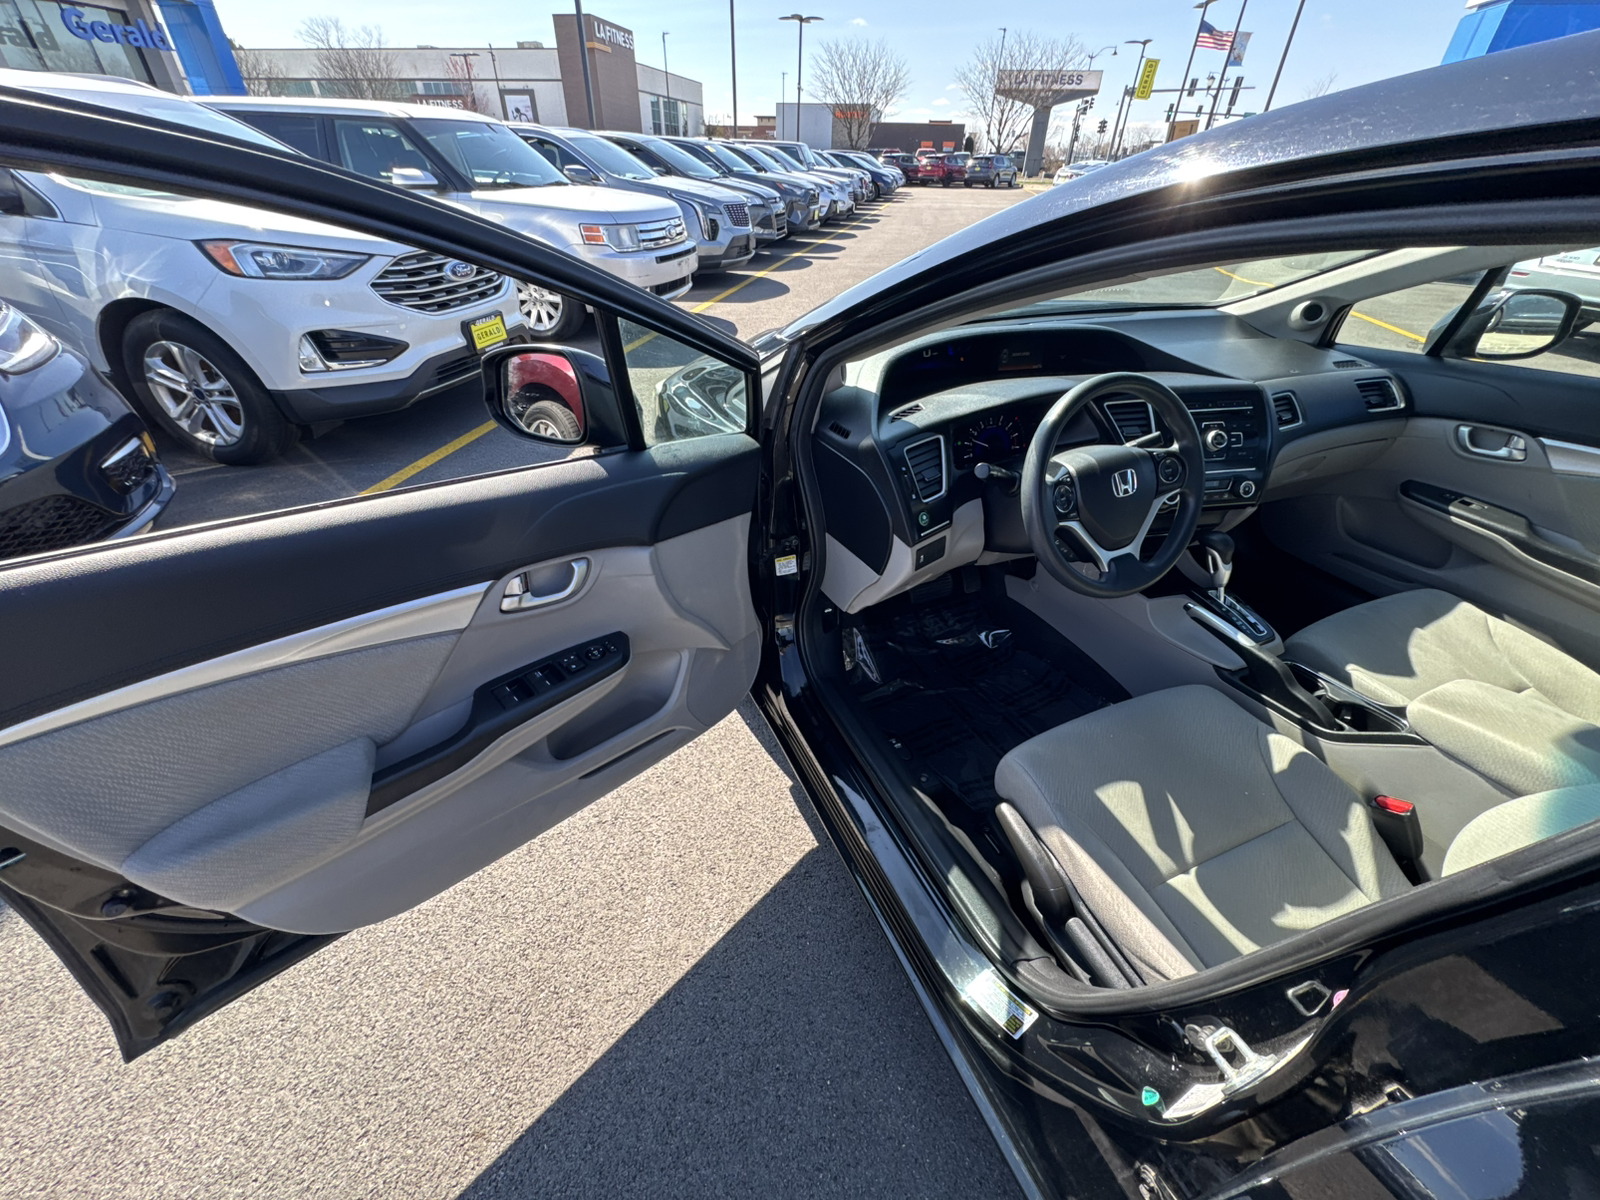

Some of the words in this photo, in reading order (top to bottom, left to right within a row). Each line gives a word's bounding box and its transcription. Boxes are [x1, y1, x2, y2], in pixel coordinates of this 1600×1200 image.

[60, 6, 171, 51] Gerald
[594, 21, 606, 40] LA
[605, 26, 634, 51] FITNESS
[1034, 74, 1084, 85] FITNESS
[1140, 63, 1154, 95] GERALD
[477, 327, 501, 341] GERALD
